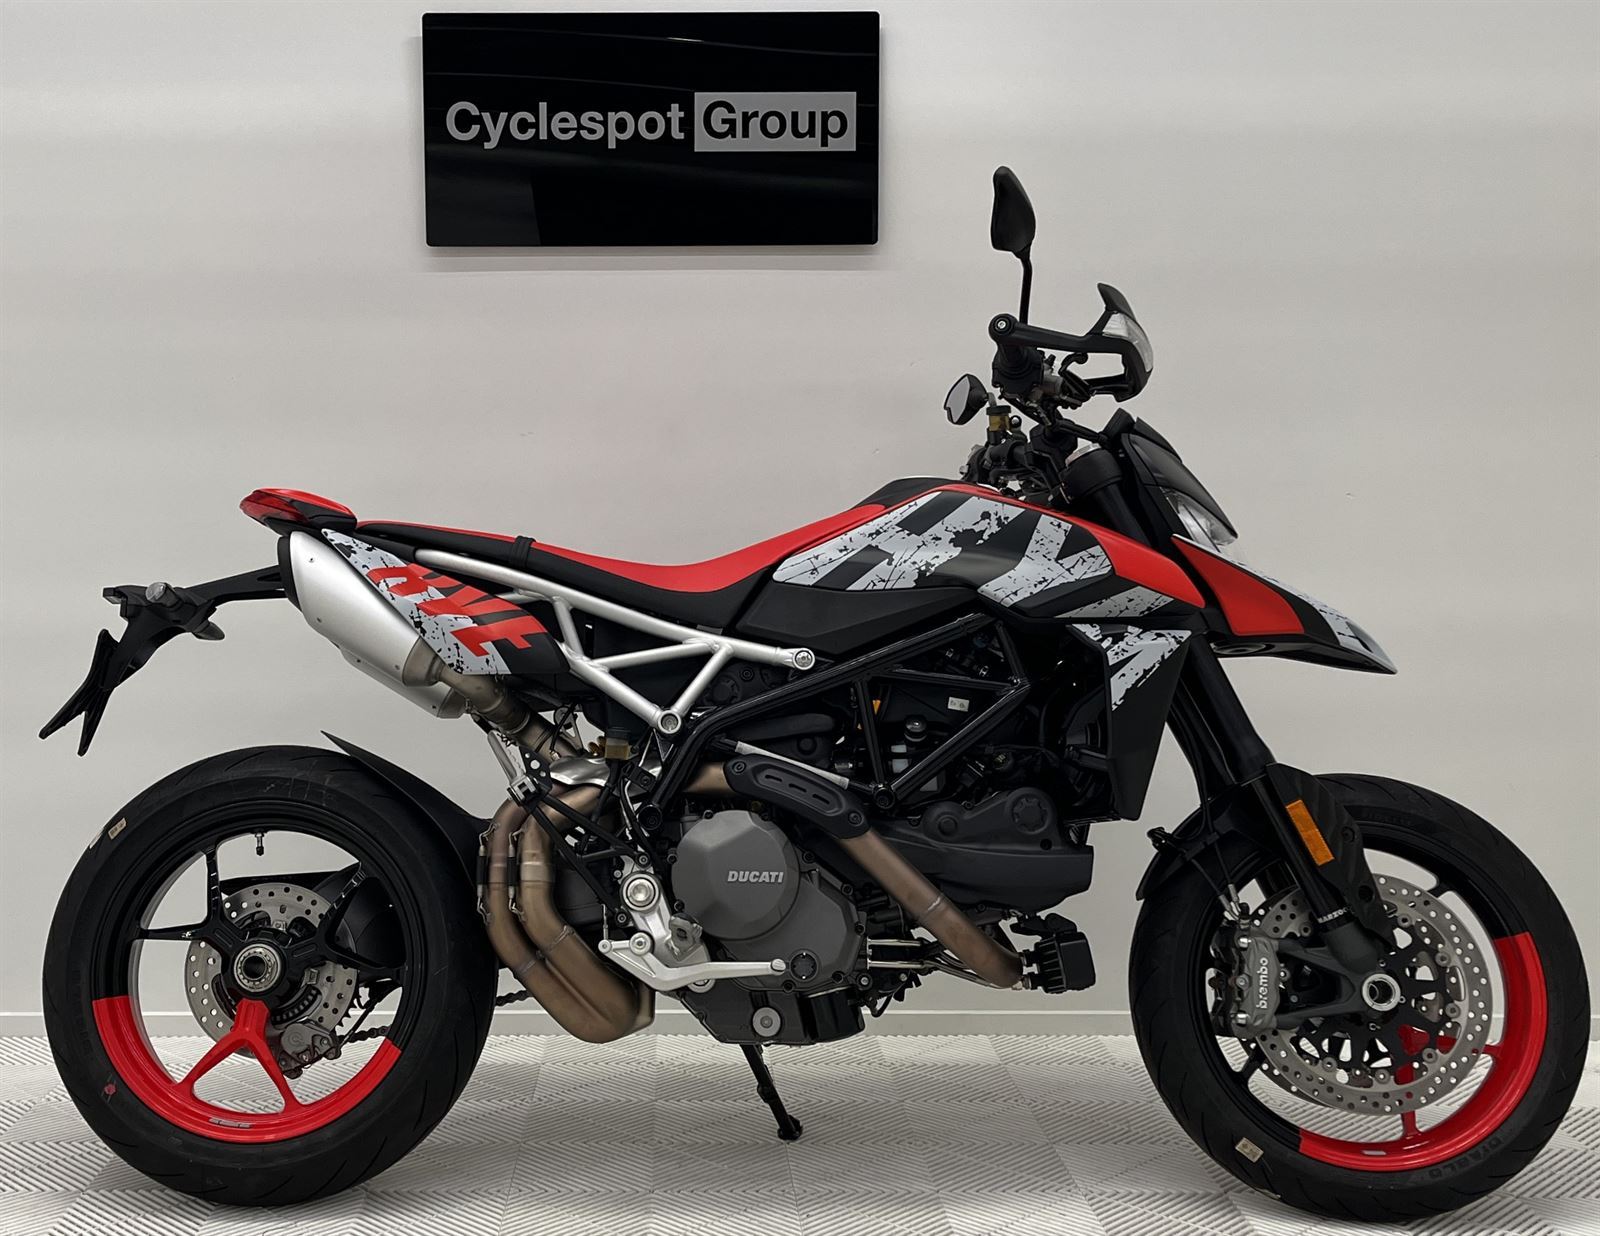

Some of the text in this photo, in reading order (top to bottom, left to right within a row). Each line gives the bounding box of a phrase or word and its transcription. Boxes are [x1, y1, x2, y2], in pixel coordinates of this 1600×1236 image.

[446, 100, 848, 150] Cyclespot Group
[727, 870, 784, 883] DUCATI
[1256, 957, 1269, 1009] brembo
